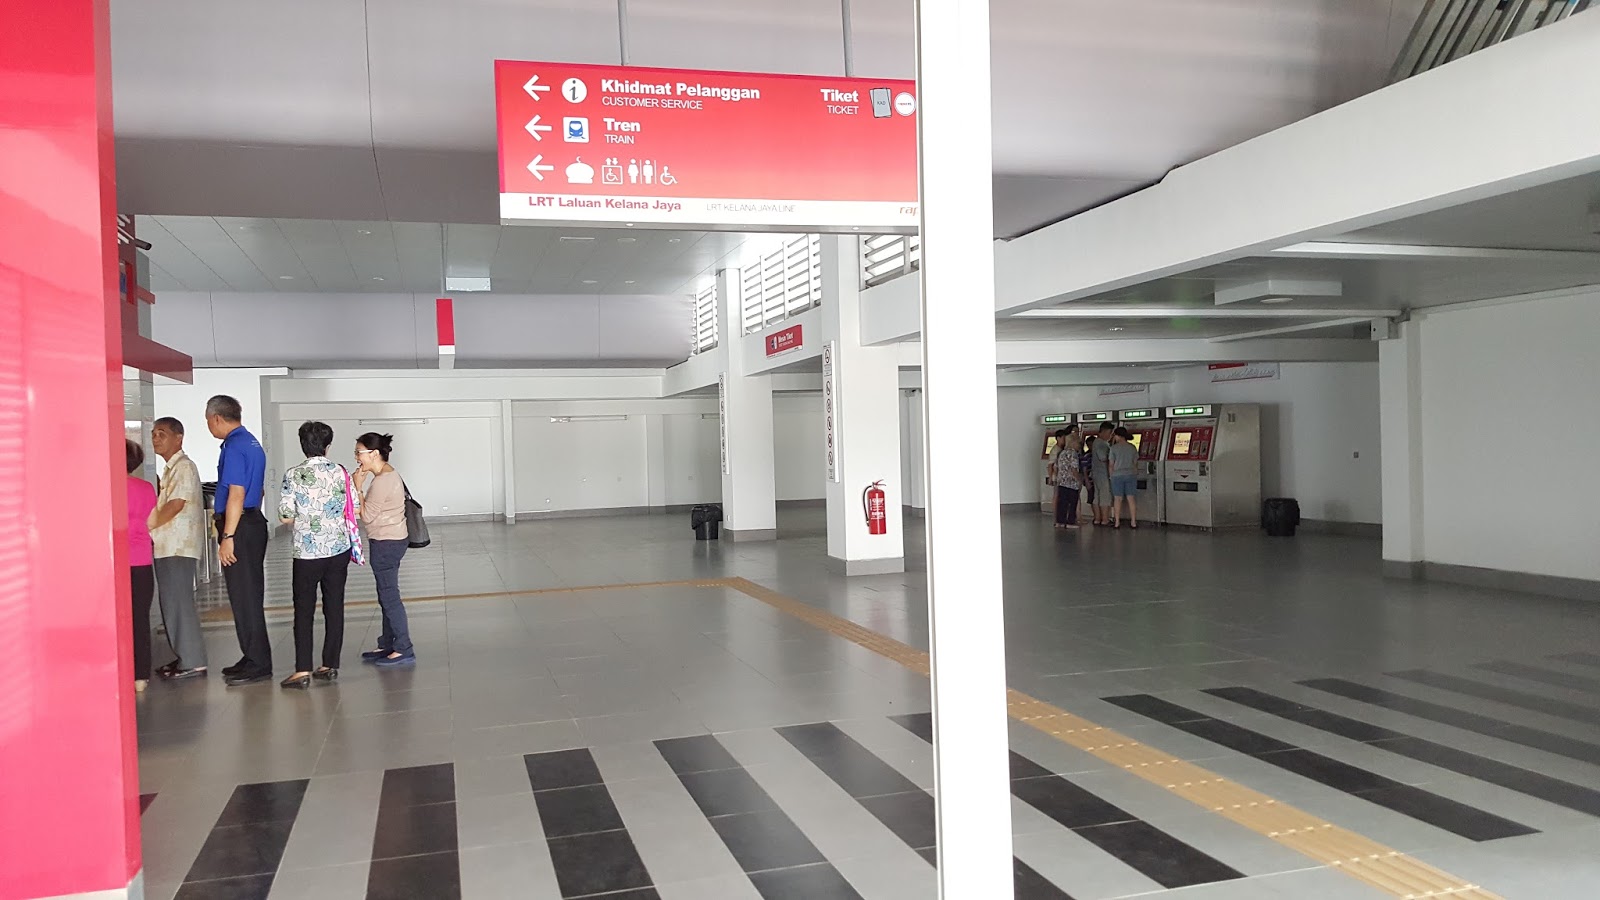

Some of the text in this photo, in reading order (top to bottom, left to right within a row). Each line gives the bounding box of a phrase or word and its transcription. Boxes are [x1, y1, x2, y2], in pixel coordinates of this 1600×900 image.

[601, 79, 760, 101] Khidmat Pelanggan
[820, 88, 859, 102] Tiket
[602, 96, 703, 110] CUSTOMER SERVICE
[827, 104, 859, 115] TICKET
[603, 118, 640, 131] Tren
[604, 134, 634, 144] TRAIN
[528, 196, 682, 212] LRT Laluan Kelana Jaya
[706, 203, 796, 213] LRT KELANA JAYA LINE
